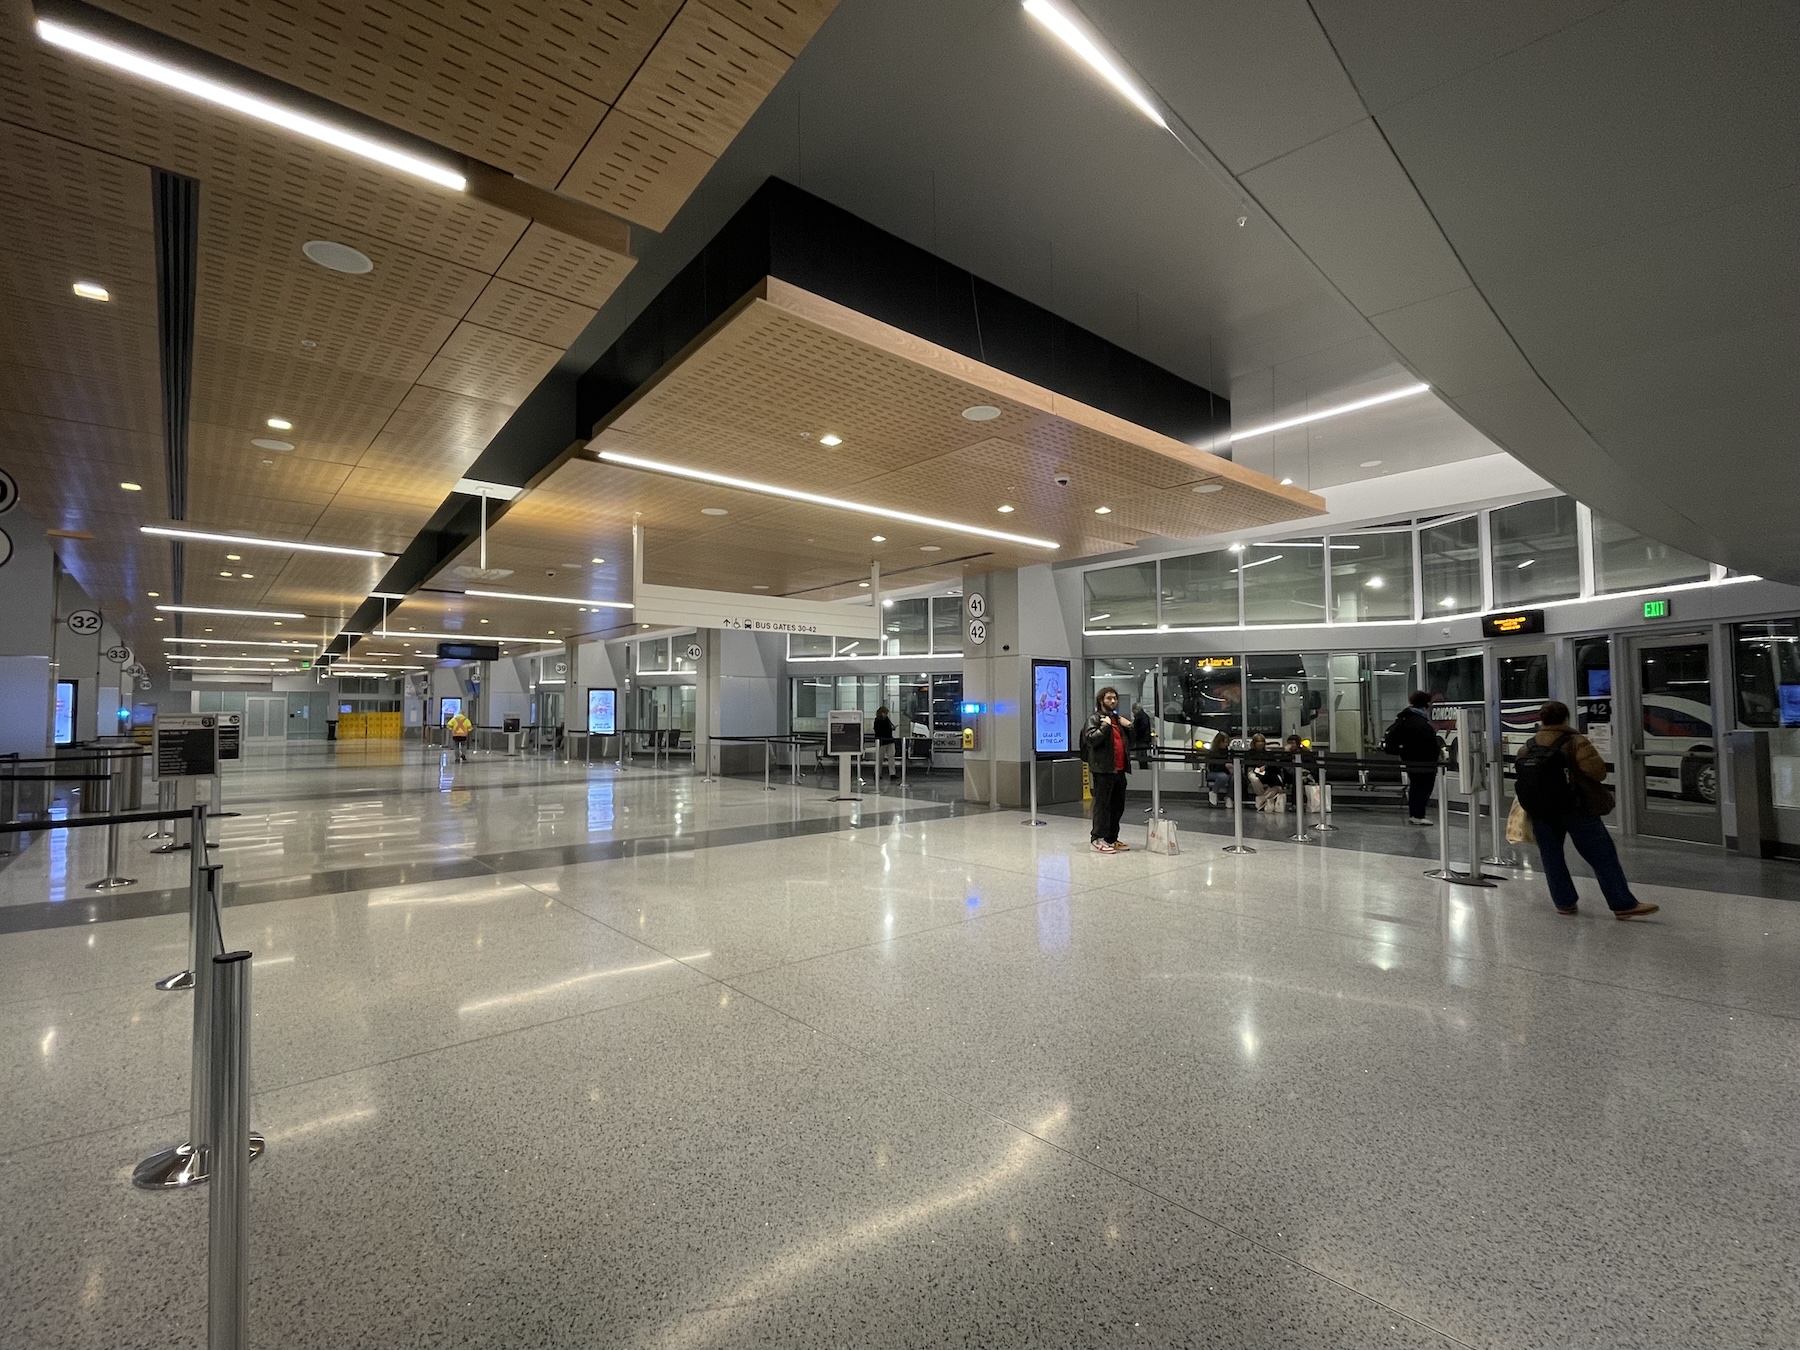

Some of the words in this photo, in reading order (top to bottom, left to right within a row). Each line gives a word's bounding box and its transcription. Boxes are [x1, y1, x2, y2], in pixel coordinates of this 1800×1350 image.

[970, 599, 982, 612] 41
[1644, 600, 1665, 618] EXIT
[71, 615, 98, 629] 32
[755, 621, 771, 630] BUS
[772, 622, 796, 632] GATES
[797, 625, 817, 633] 30-42
[971, 625, 984, 639] 42
[109, 649, 127, 659] 33
[688, 647, 701, 657] 40
[556, 664, 567, 673] 39
[1431, 706, 1461, 720] CONCOR
[1590, 703, 1607, 715] 42
